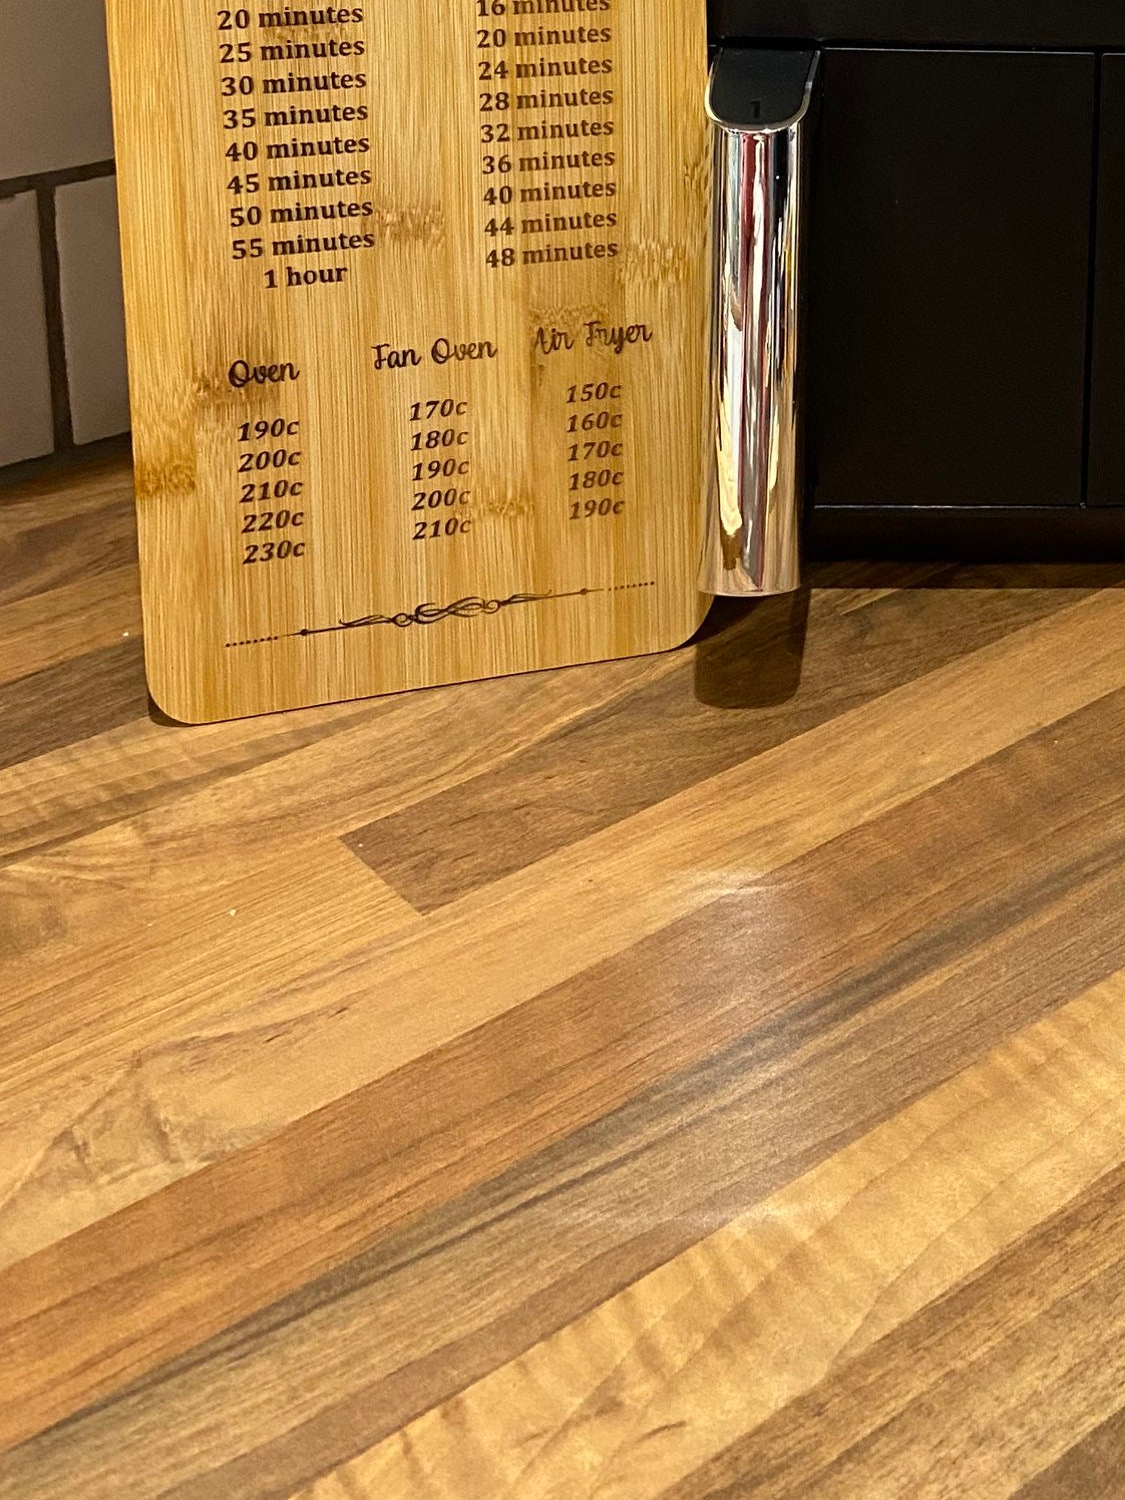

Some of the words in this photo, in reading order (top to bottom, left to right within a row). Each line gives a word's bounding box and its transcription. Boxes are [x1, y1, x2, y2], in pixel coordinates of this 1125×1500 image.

[476, 28, 507, 49] 20
[514, 25, 612, 46] minutes
[219, 42, 252, 63] 25
[260, 38, 365, 61] minutes
[221, 75, 254, 96] 30
[262, 71, 367, 94] minutes
[479, 91, 510, 112] 28
[516, 87, 614, 109] minutes
[223, 108, 256, 129] 35
[264, 103, 368, 127] minutes
[480, 123, 511, 143] 32
[517, 118, 615, 141] minutes
[225, 140, 258, 162] 40
[266, 135, 370, 159] minutes
[482, 154, 512, 174] 36
[518, 149, 616, 172] minutes
[227, 173, 260, 194] 45
[268, 168, 372, 192] minutes
[483, 185, 513, 205] 40
[520, 180, 617, 203] minutes
[229, 206, 262, 227] 50
[270, 199, 373, 224] minutes
[484, 216, 514, 236] 44
[521, 210, 618, 234] minutes
[231, 238, 264, 260] 55
[272, 231, 375, 256] minutes
[264, 270, 277, 289] 1
[286, 264, 348, 287] hour
[534, 327, 574, 355] Air
[583, 321, 653, 356] Fryer
[371, 342, 421, 370] Fan
[431, 338, 498, 364] Oven
[228, 359, 300, 388] Oven
[566, 382, 622, 404] 150c
[408, 399, 468, 421] 170c
[566, 411, 623, 432] 160c
[237, 418, 300, 442] 190c
[410, 429, 469, 451] 180c
[238, 449, 302, 473] 200c
[568, 440, 623, 461] 170c
[412, 459, 470, 481] 190c
[569, 469, 624, 491] 180c
[239, 480, 304, 504] 210c
[411, 489, 471, 510] 200c
[569, 498, 625, 520] 190c
[241, 510, 304, 534] 220c
[412, 518, 472, 540] 210c
[243, 540, 305, 564] 230c
